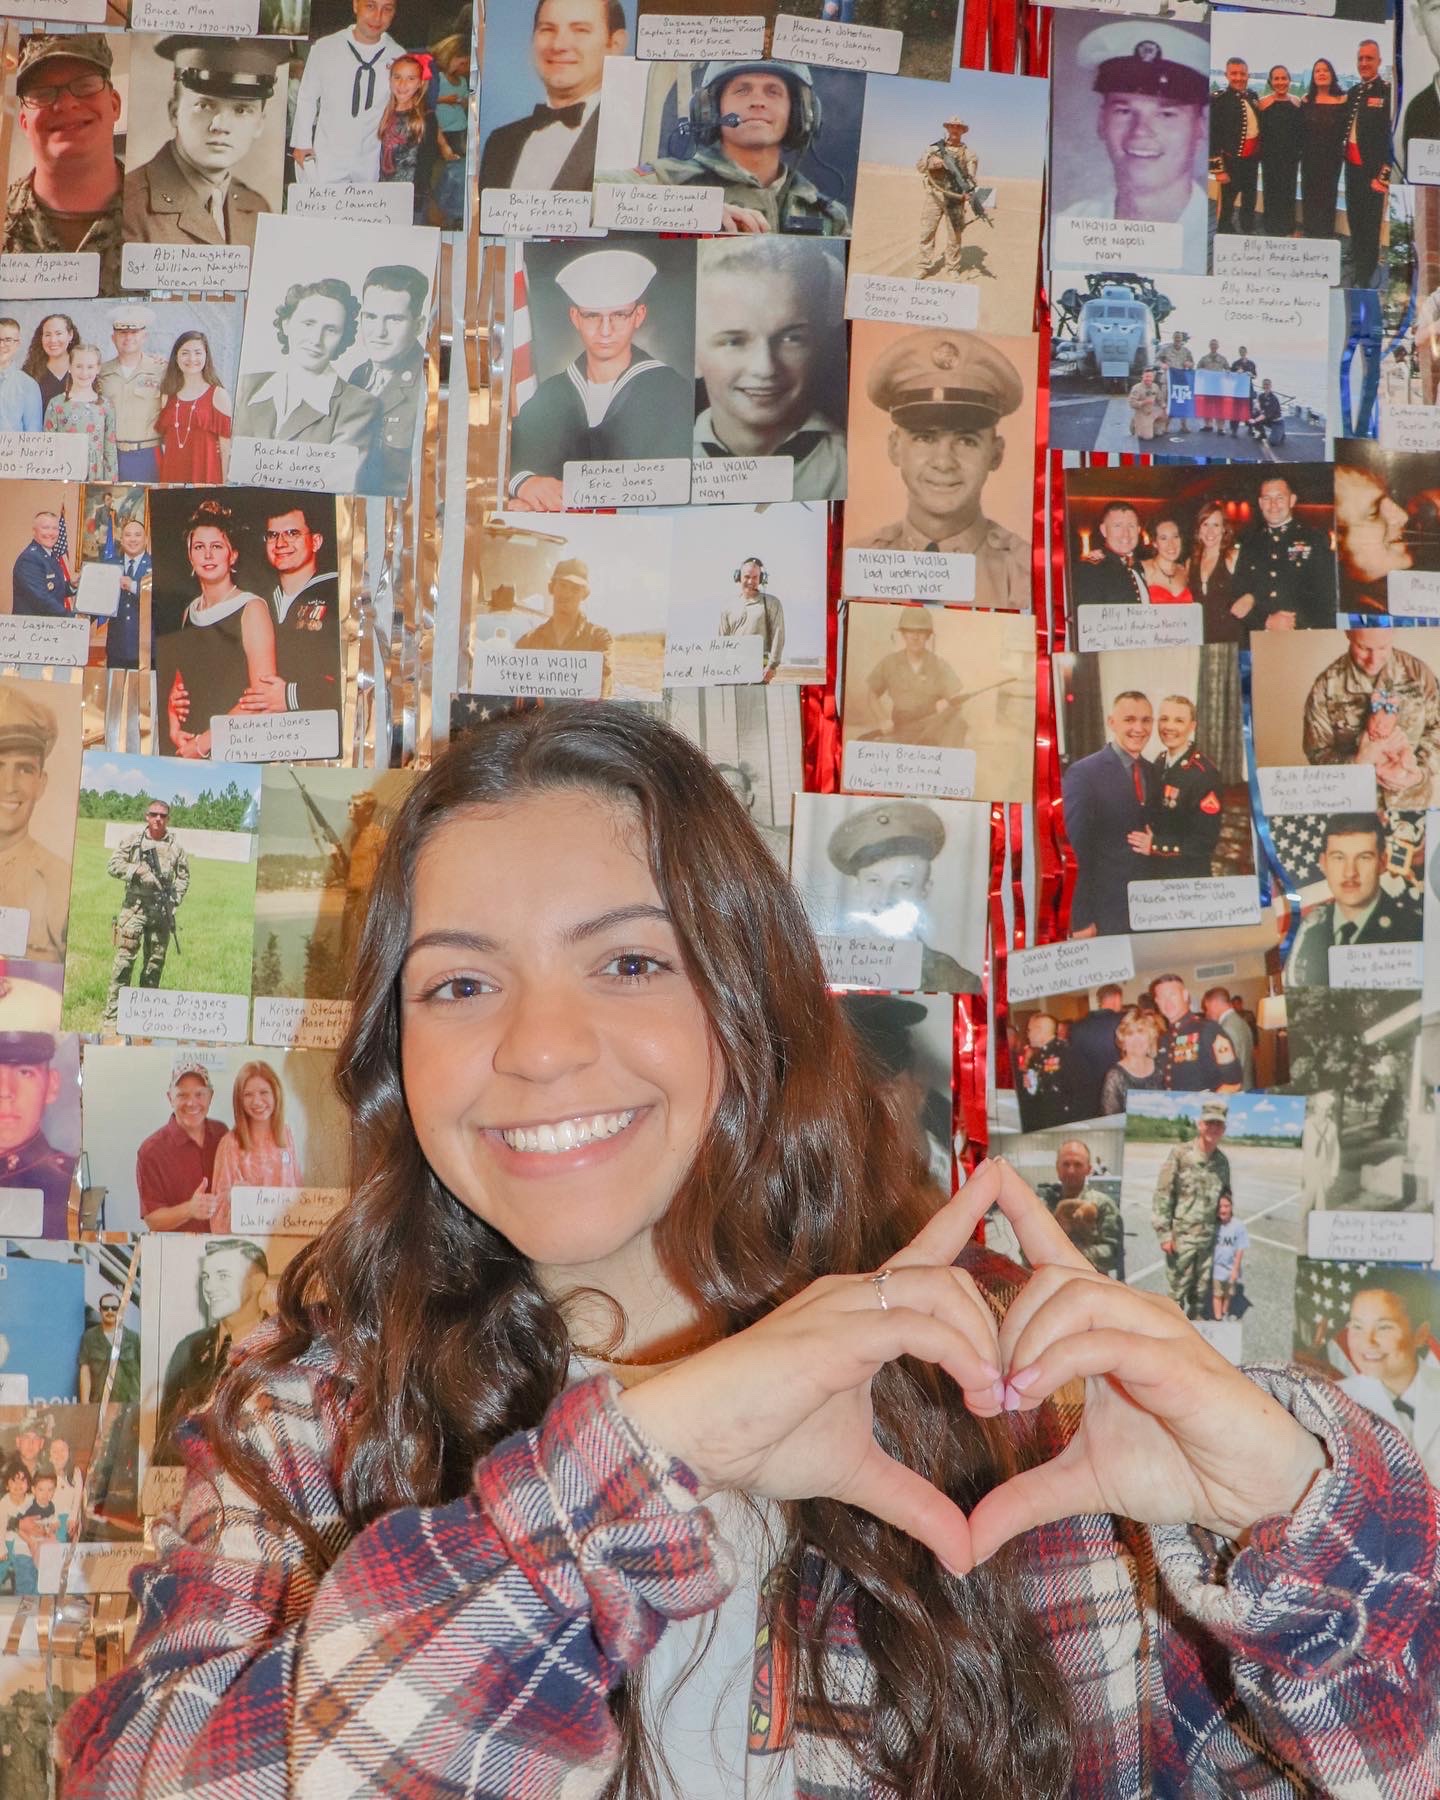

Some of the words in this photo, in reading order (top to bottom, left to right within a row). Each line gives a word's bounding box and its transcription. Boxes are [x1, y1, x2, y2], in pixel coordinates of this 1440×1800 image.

[509, 192, 547, 209] Bailey
[552, 192, 590, 206] French
[488, 206, 518, 220] Larry
